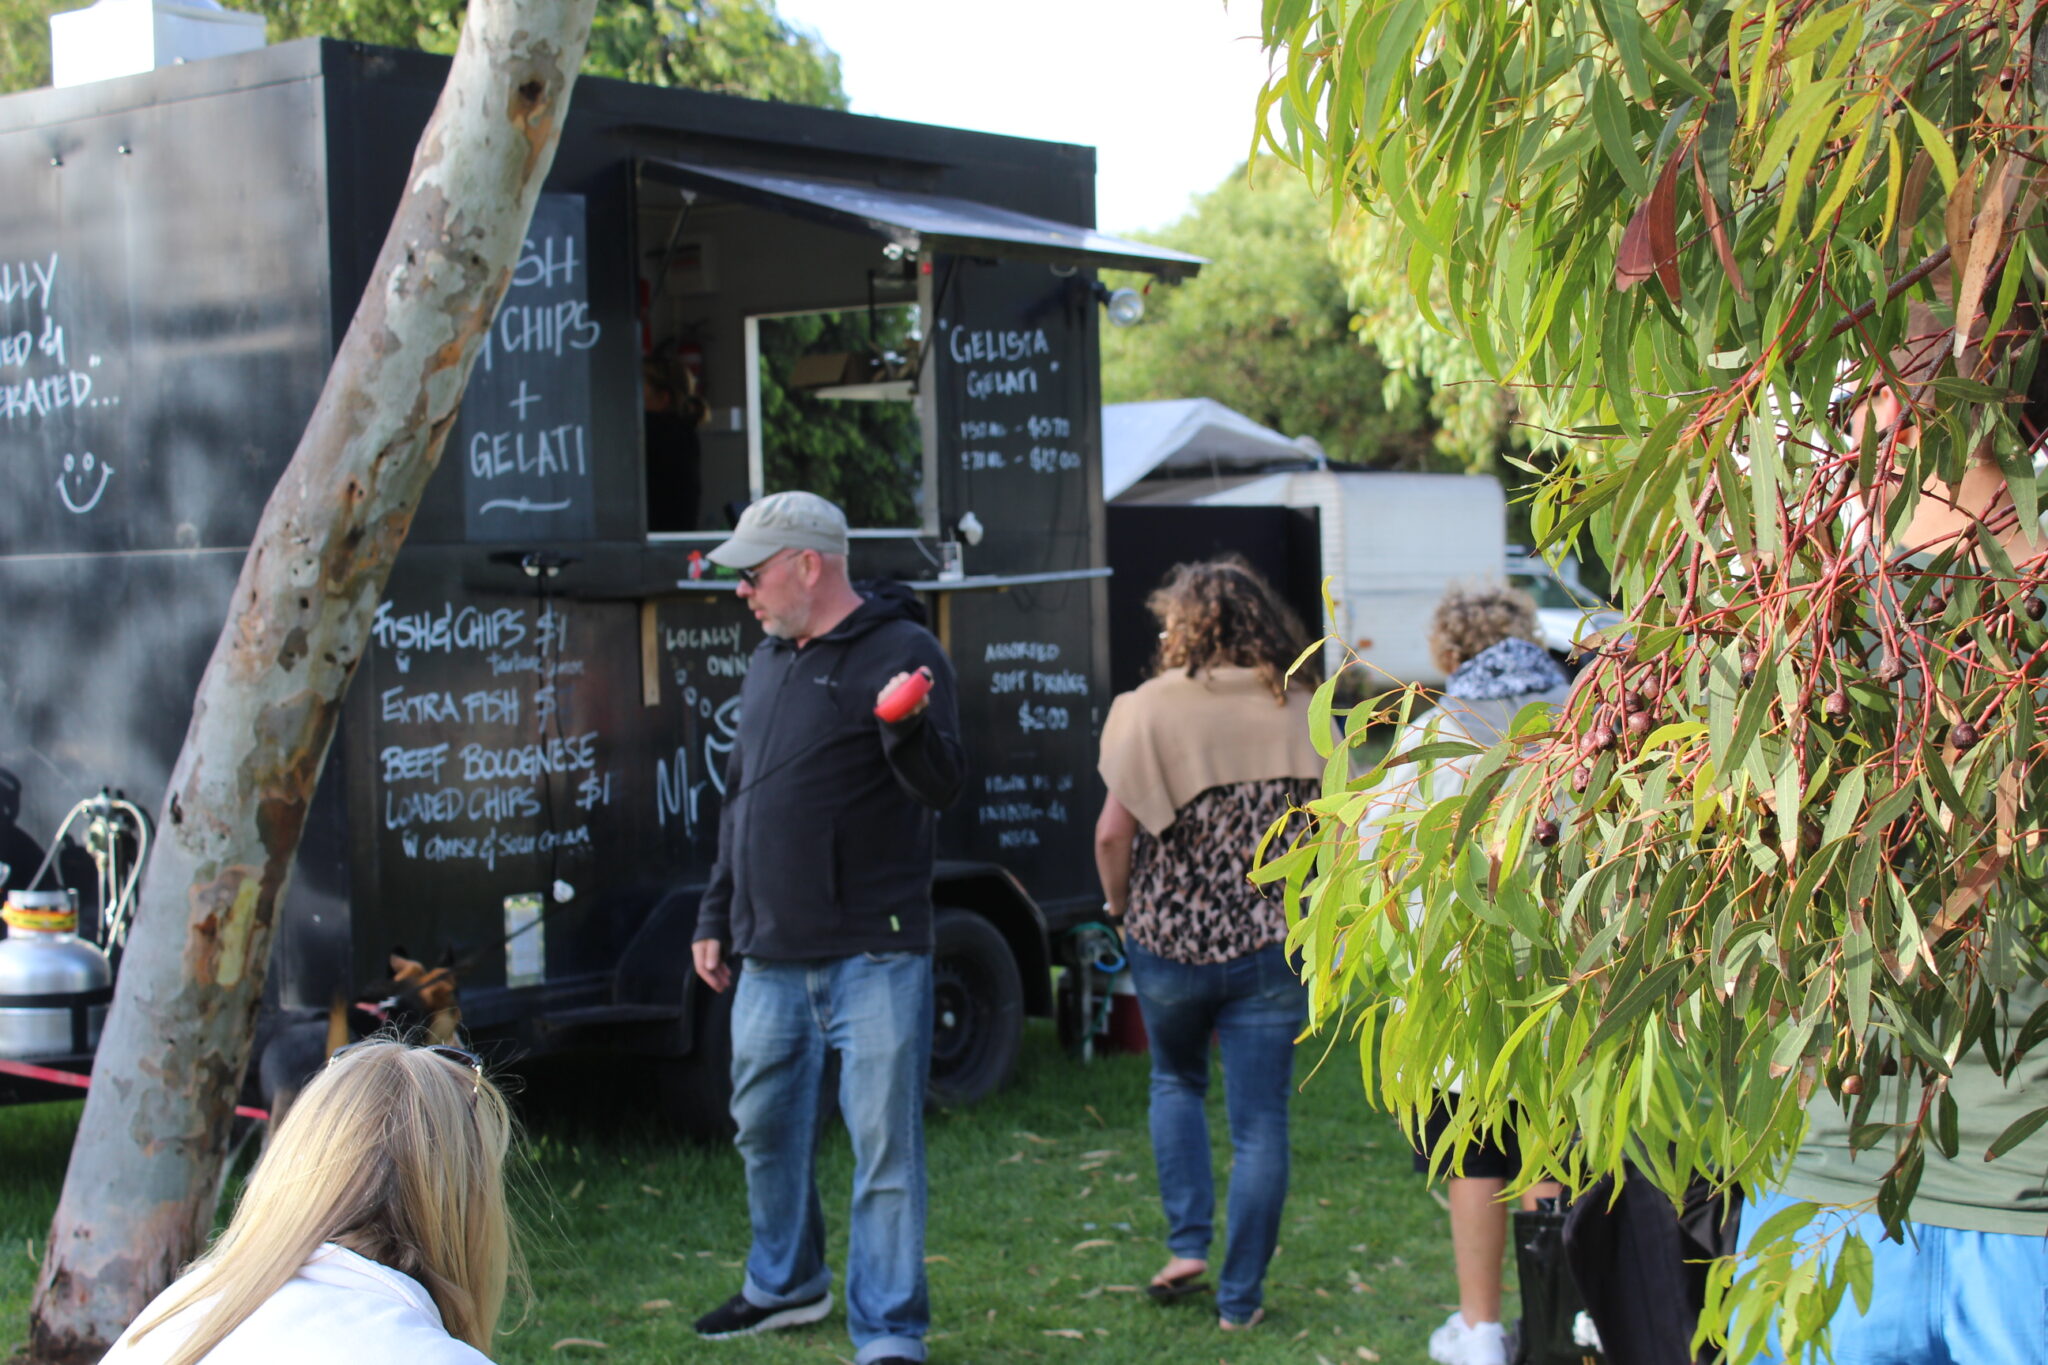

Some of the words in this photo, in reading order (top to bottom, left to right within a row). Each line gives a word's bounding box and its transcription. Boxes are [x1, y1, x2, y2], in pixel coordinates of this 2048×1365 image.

[0, 252, 58, 309] LLY
[511, 236, 580, 288] SH
[500, 300, 600, 357] CHIPS
[966, 366, 1039, 400] GELATI
[469, 424, 586, 480] GELATI
[453, 605, 527, 652] CHIPS
[666, 622, 742, 653] LOCALLY
[381, 684, 461, 726] EXTRA
[461, 686, 520, 727] FISH
[380, 741, 450, 786] BEEF
[459, 730, 600, 786] BOLOGNESE
[385, 786, 465, 831] LOADED
[467, 784, 542, 824] CHIPS
